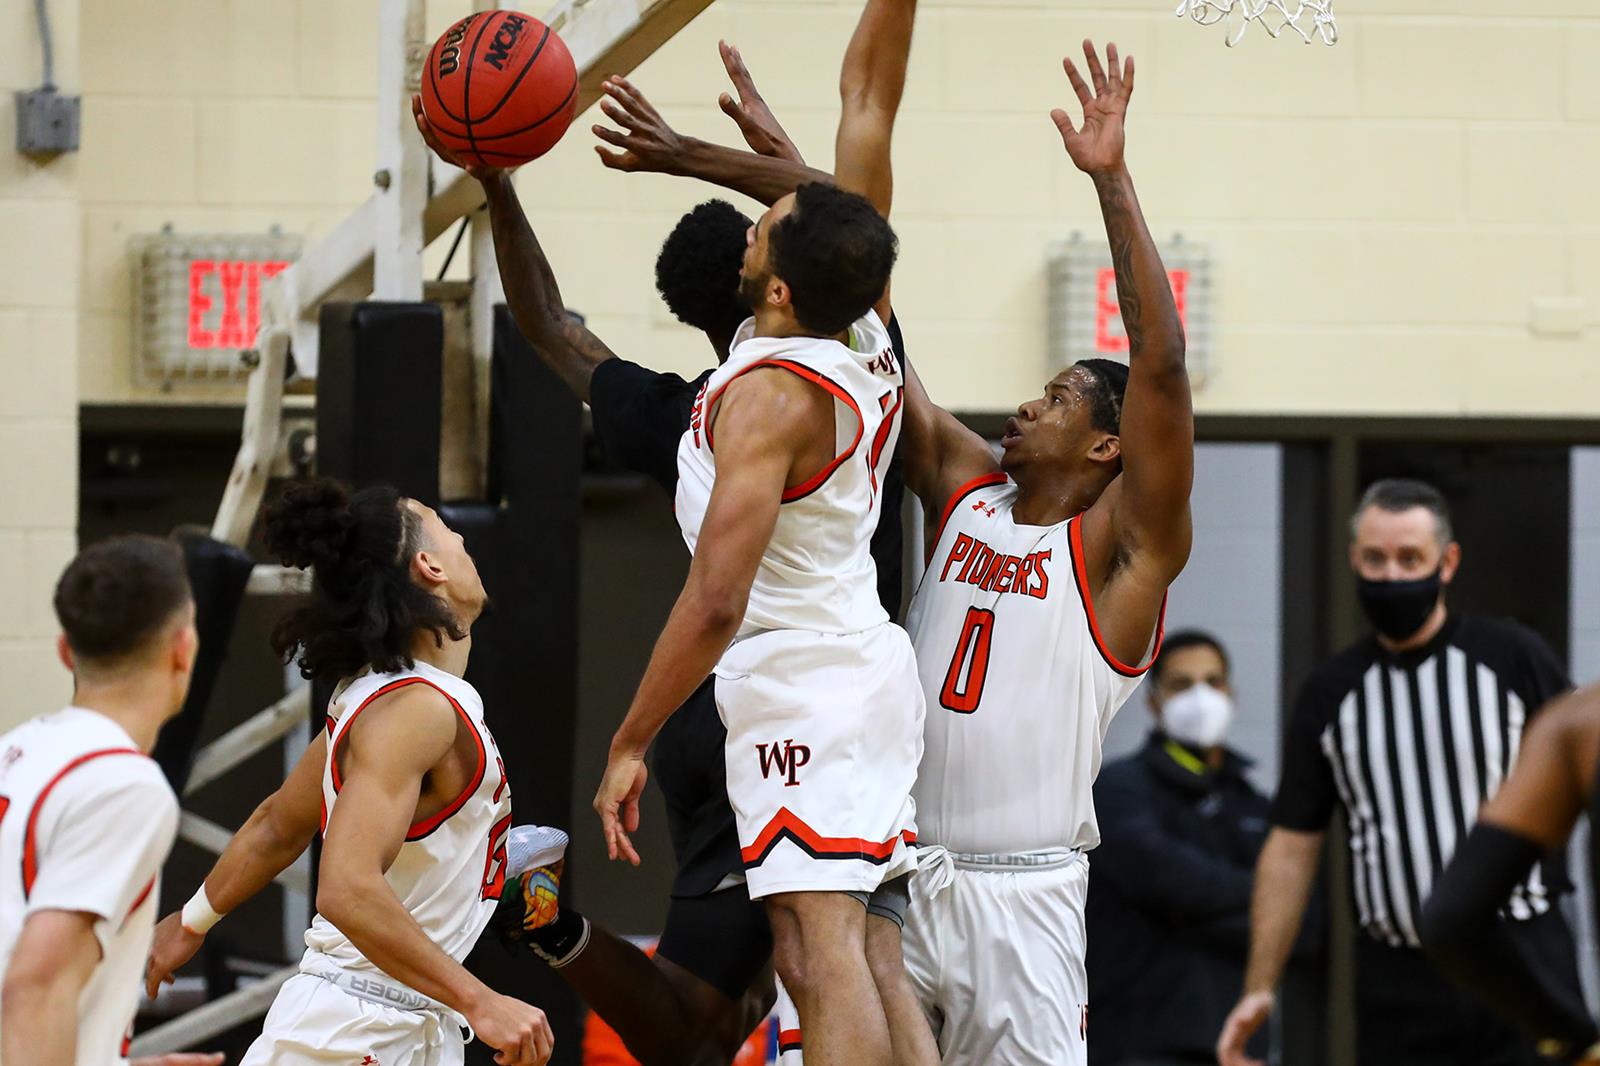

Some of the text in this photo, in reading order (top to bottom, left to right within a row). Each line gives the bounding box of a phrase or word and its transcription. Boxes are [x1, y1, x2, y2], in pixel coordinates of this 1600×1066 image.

[484, 14, 528, 71] NCAA
[939, 605, 996, 714] 0
[755, 738, 811, 787] WP
